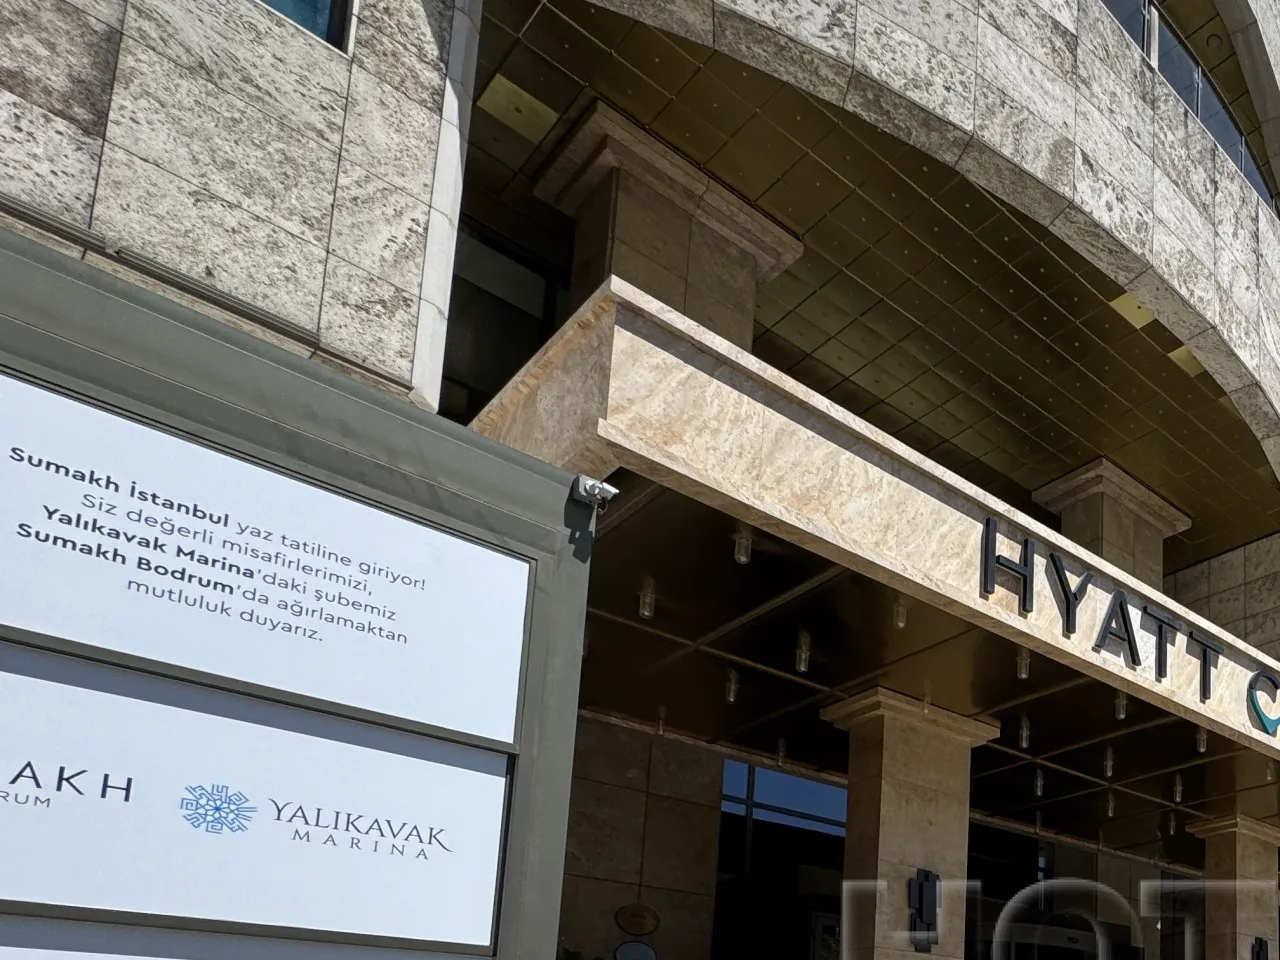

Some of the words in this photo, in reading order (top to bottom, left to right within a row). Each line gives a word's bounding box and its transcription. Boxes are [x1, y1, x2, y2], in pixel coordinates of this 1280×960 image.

[9, 446, 120, 493] Sumakh
[130, 480, 230, 528] İstanbul
[235, 521, 274, 543] yaz
[281, 534, 352, 567] tatiline
[358, 561, 426, 591] giriyor!
[43, 504, 168, 554] Yalıkavak
[314, 588, 398, 622] şubemiz
[81, 493, 118, 516] Siz
[126, 508, 215, 545] değerli
[222, 538, 373, 597] misafirlerimizi,
[16, 523, 127, 566] Sumakh
[277, 600, 408, 645] ağırlamaktan
[127, 579, 232, 618] mutluluk
[239, 608, 324, 642] duyarız.
[981, 516, 1225, 704] HYATT
[268, 797, 454, 853] YALIKAVAK
[291, 828, 430, 861] MARINA
